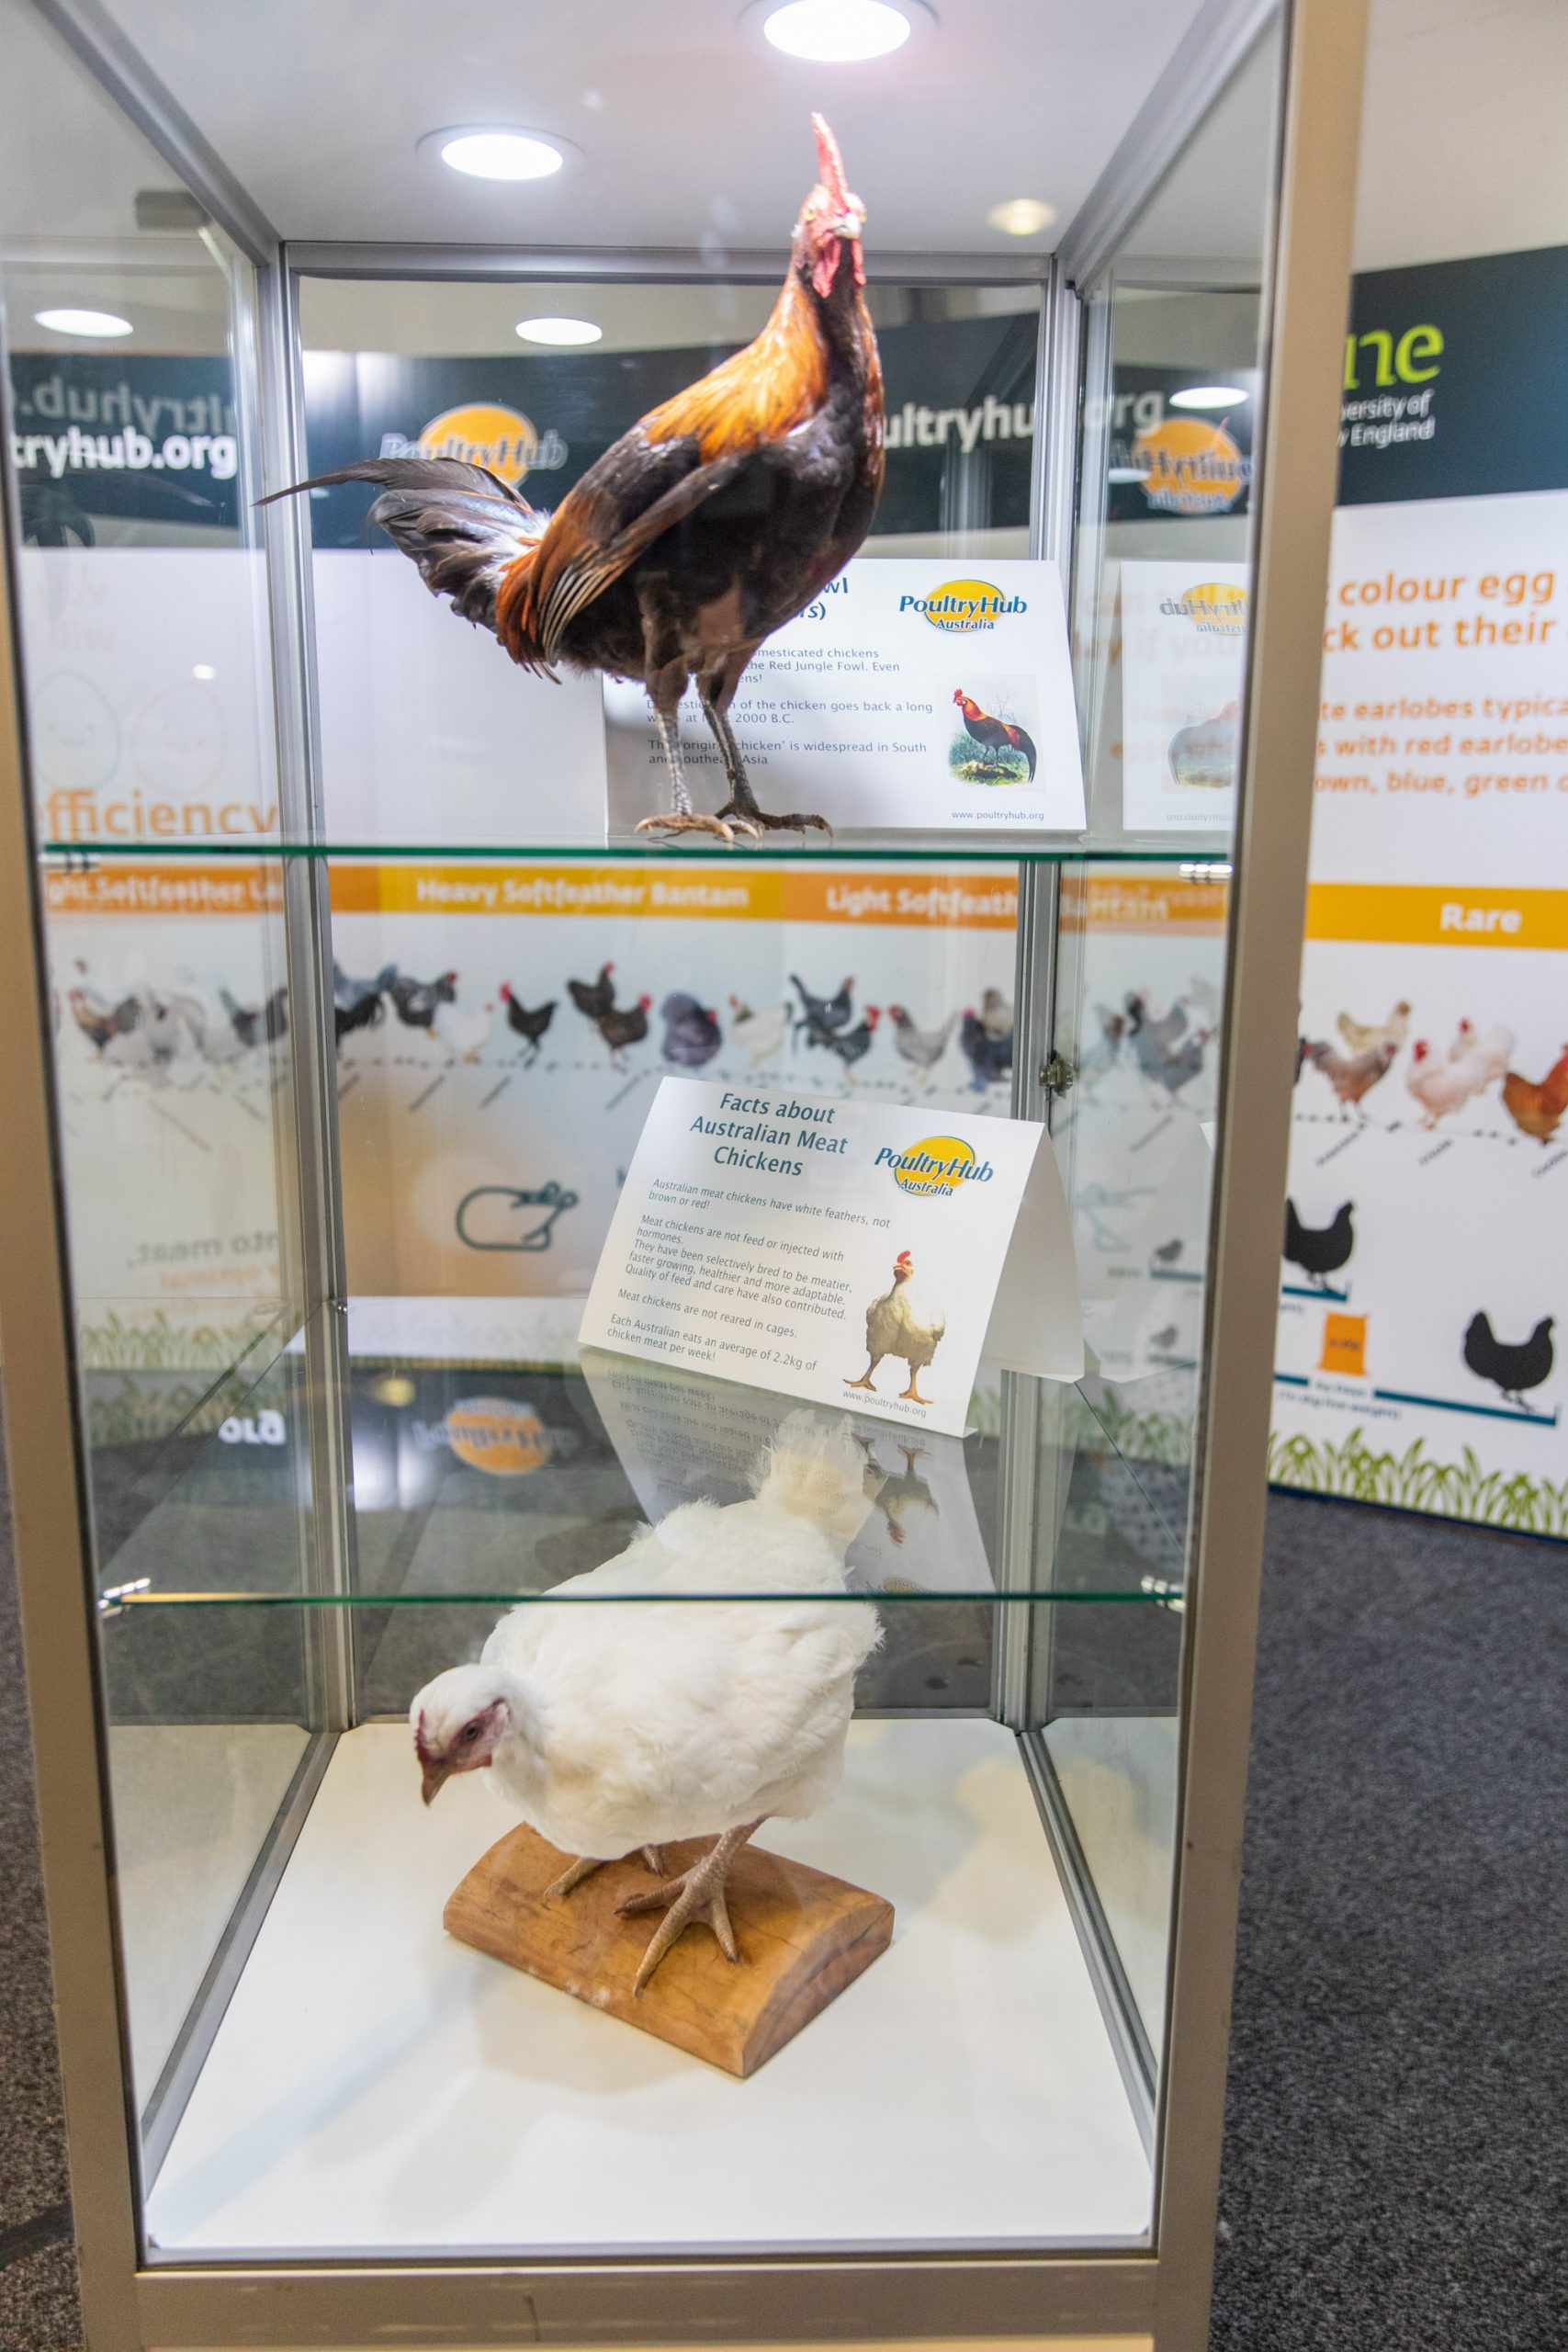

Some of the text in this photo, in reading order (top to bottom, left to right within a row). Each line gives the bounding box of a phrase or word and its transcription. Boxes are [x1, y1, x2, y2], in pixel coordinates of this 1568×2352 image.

[1343, 323, 1445, 390] ne
[1405, 388, 1435, 418] of
[1350, 414, 1436, 449] England
[12, 424, 238, 479] tryhub.org
[823, 576, 849, 594] wl
[1338, 571, 1555, 607] colour egg
[898, 594, 1028, 618] PoultryHub
[935, 617, 995, 630] Australia
[1322, 610, 1556, 652] ck out their
[753, 646, 879, 659] mesticated chickens
[768, 660, 791, 672] Red
[795, 661, 834, 673] Jungle
[837, 661, 869, 672] Fowl.
[872, 662, 899, 672] Even
[685, 713, 699, 723] at
[735, 713, 767, 723] 2000
[771, 713, 795, 724] B.C.
[740, 699, 754, 710] of
[756, 699, 777, 710] the
[780, 700, 827, 711] chicken
[830, 703, 860, 714] goes
[863, 701, 892, 711] back
[906, 702, 933, 714] long
[1353, 697, 1473, 721] earlobes
[1483, 692, 1568, 722] typica
[742, 754, 769, 764] Asia
[790, 741, 800, 751] is
[803, 741, 873, 753] widespread
[877, 741, 888, 752] in
[892, 741, 927, 752] South
[1334, 732, 1397, 756] with
[1404, 734, 1451, 756] red
[1458, 731, 1568, 755] earlobe
[1386, 769, 1455, 795] blue,
[1463, 774, 1548, 798] green
[46, 787, 276, 842] fficiency
[951, 809, 1044, 821] www.poultryhub.org
[416, 876, 750, 910] Heavy Softfeather Bantam
[827, 884, 1018, 919] Light Softfeath
[1438, 900, 1524, 935] Rare
[719, 1091, 836, 1125] Facts about
[689, 1115, 849, 1155] Australian Meat
[713, 1146, 803, 1177] Chickens
[874, 1147, 994, 1183] PoultryHub
[649, 1191, 711, 1210] brown or red!
[651, 1178, 890, 1228] Australian meat chickens have white feathers, not
[897, 1177, 954, 1197] Australia
[637, 1227, 684, 1245] hormones.
[641, 1214, 844, 1262] Meat chickens are not feed or injected with
[628, 1250, 846, 1306] faster growing, healthier and more adaptable.
[634, 1238, 852, 1294] They have been selectively bred to be meatier,
[625, 1263, 847, 1320] Quality of feed and care have also contributed.
[617, 1288, 797, 1339] Meat chickens are not reared in cages.
[606, 1328, 716, 1362] chicken meat per week!
[610, 1313, 818, 1372] Each Australian eats an average of 2.2kg of
[842, 1389, 927, 1419] www.poultryhub.org
